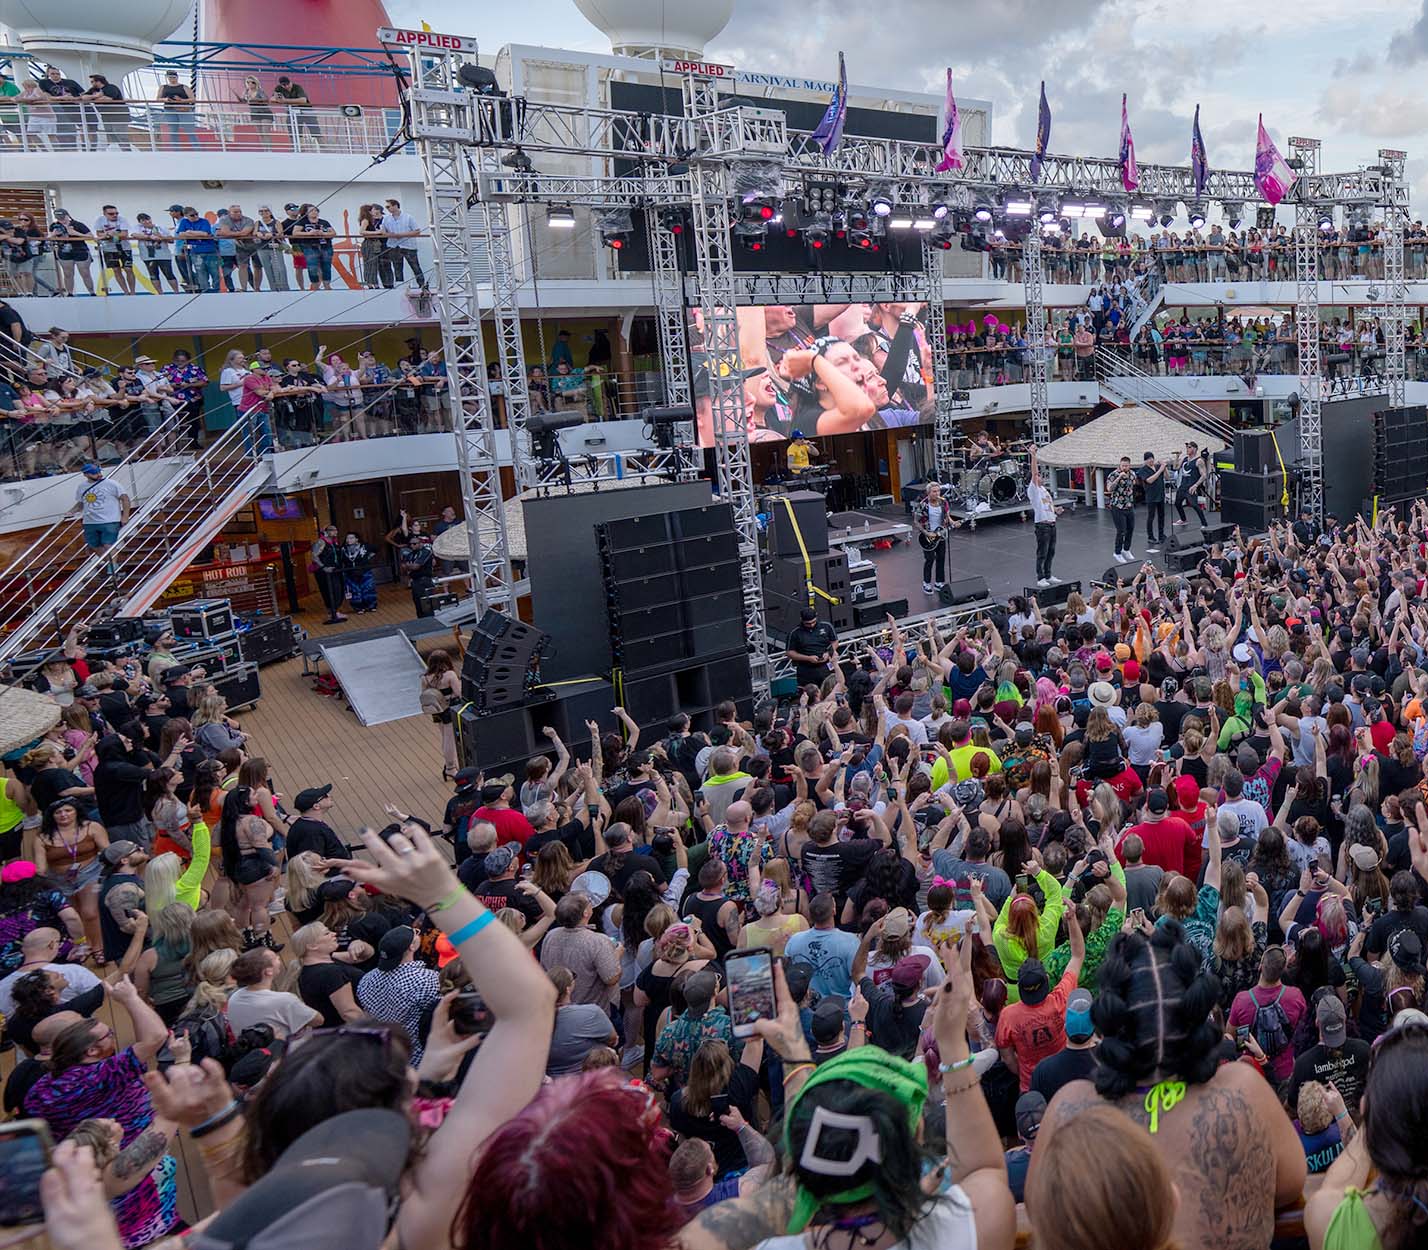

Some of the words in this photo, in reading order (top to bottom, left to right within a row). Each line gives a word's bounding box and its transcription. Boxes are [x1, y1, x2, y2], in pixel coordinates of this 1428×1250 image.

[396, 31, 461, 49] APPLIED
[674, 61, 724, 76] APPLIED
[803, 80, 839, 92] MAGI
[204, 569, 223, 581] HOT
[226, 566, 245, 579] ROD
[1314, 1061, 1334, 1074] lamb
